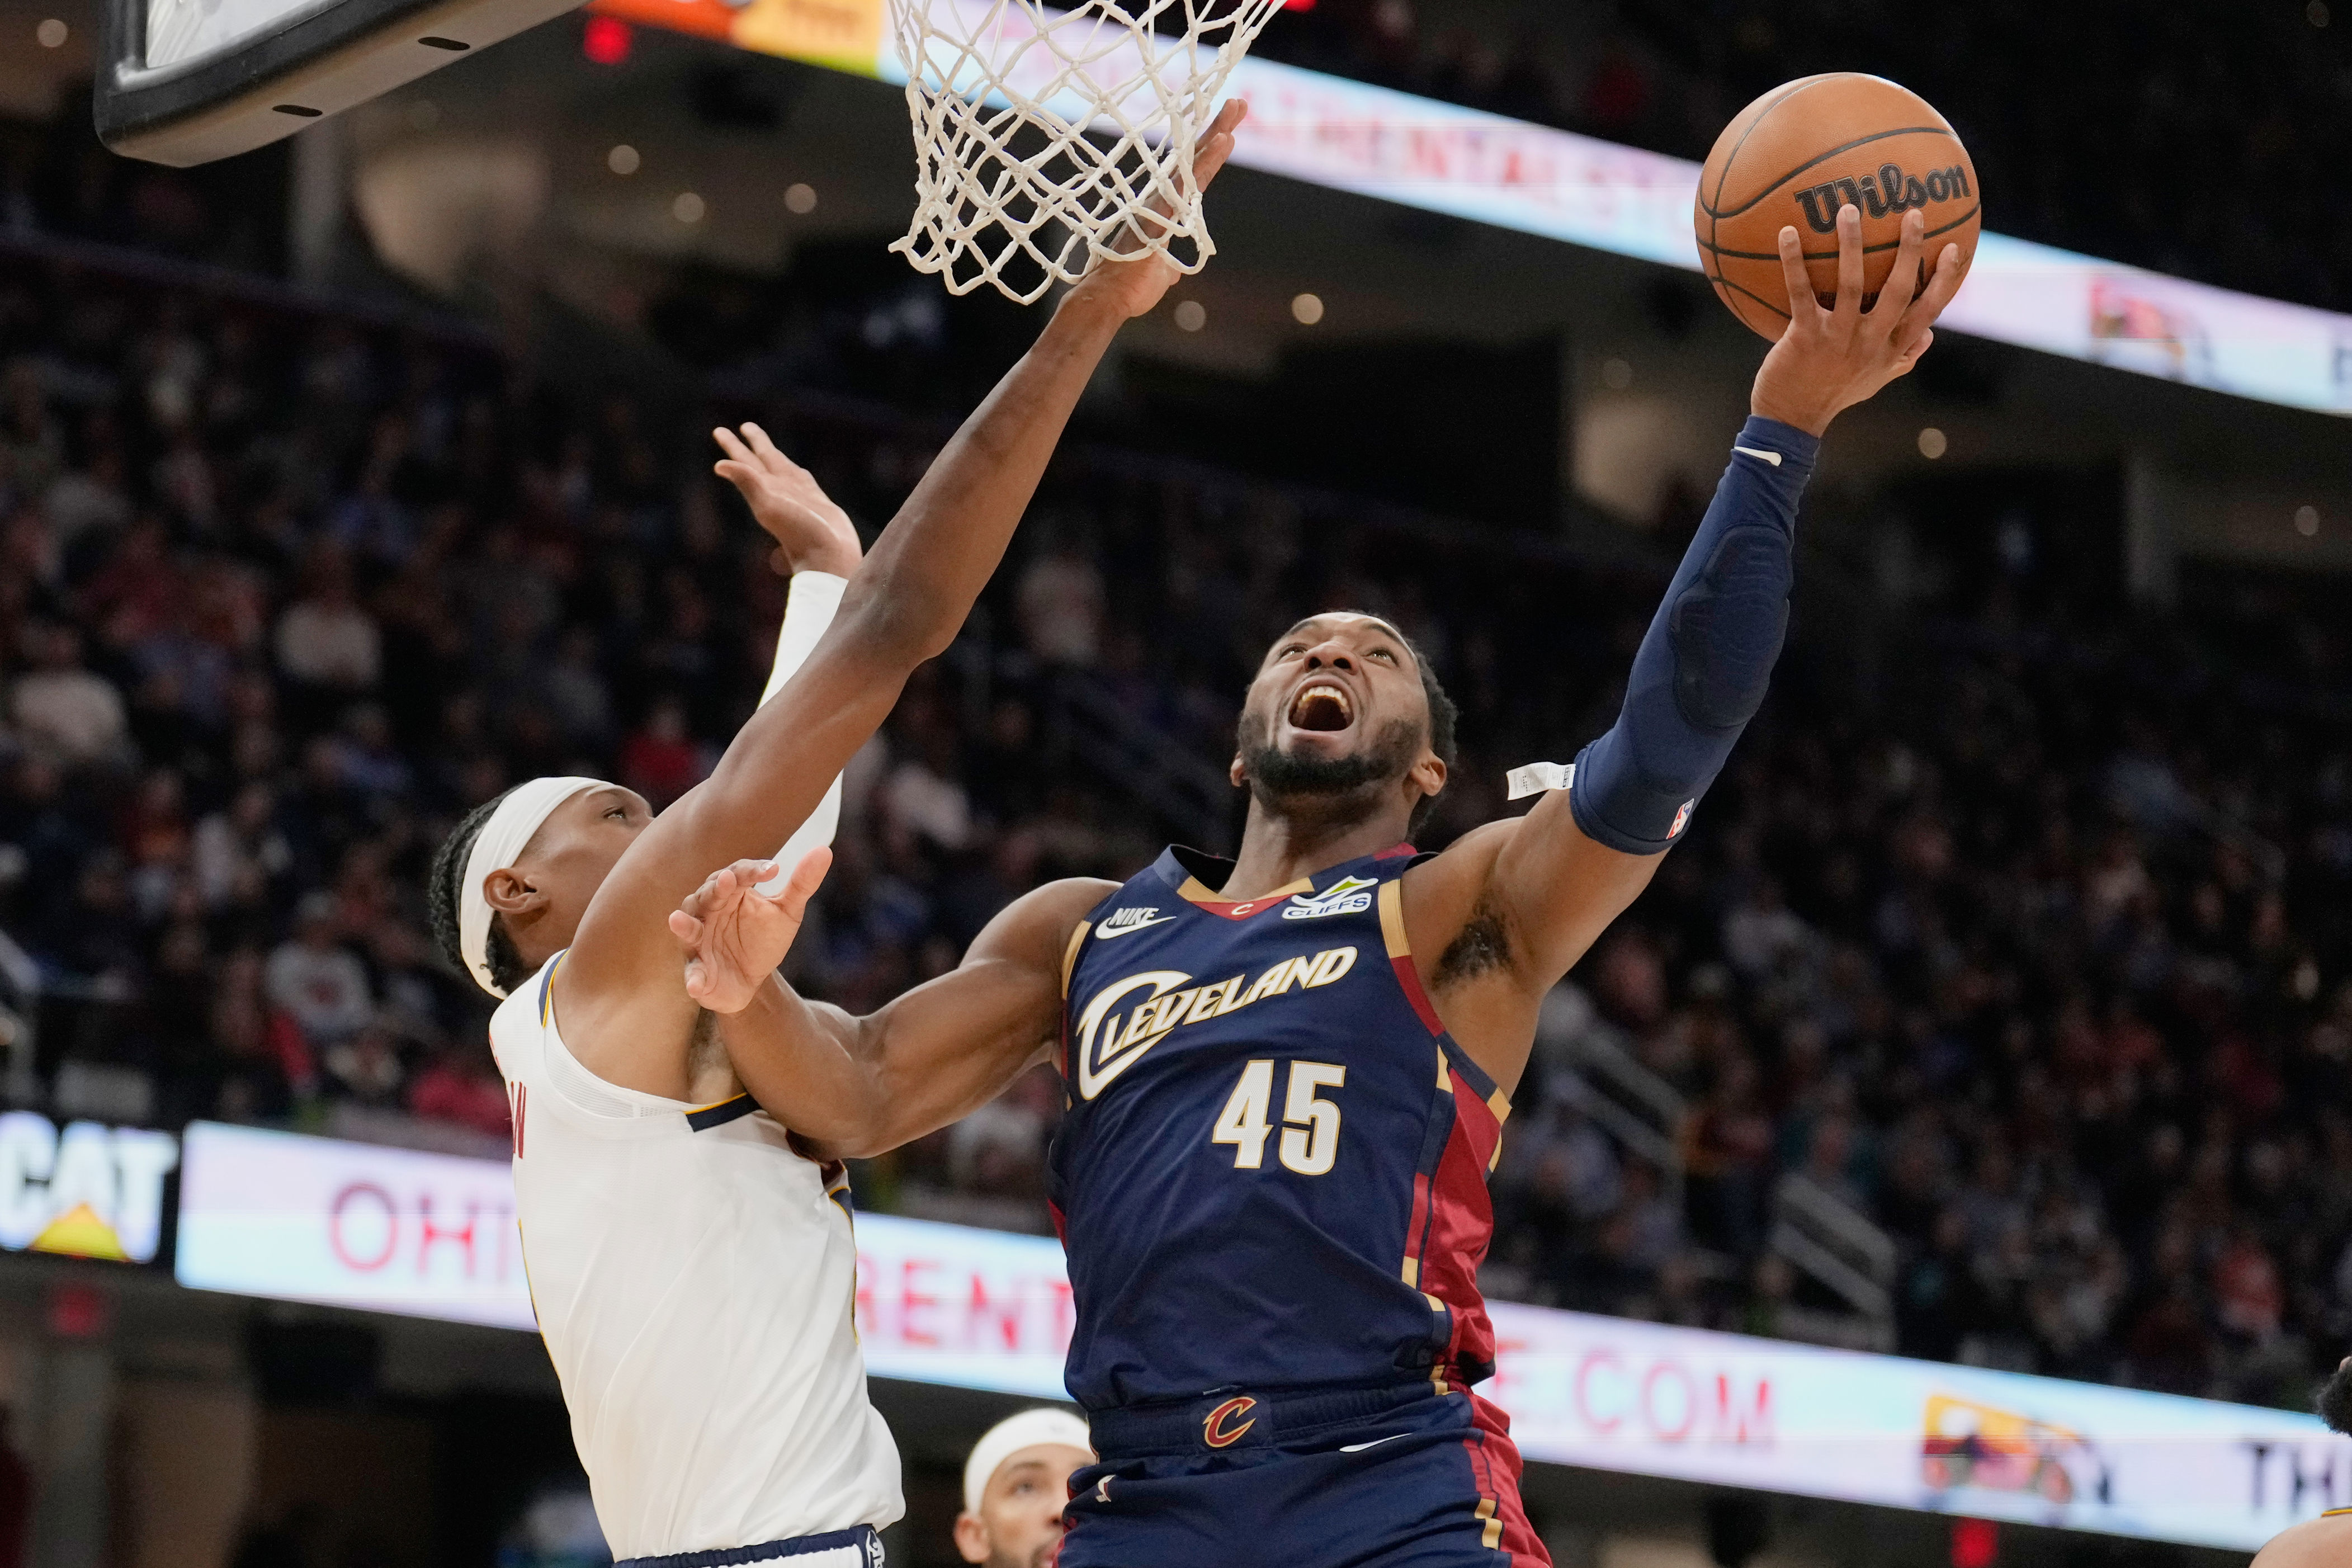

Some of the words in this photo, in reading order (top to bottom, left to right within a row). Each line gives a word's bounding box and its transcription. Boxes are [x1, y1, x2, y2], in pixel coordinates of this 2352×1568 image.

[1794, 163, 1971, 235] Wilson
[1108, 907, 1160, 925] NIKE
[1288, 897, 1368, 917] CLIFFS
[1076, 946, 1358, 1101] CLEVELAND
[1212, 1060, 1346, 1175] 45
[0, 1110, 179, 1265] CAT
